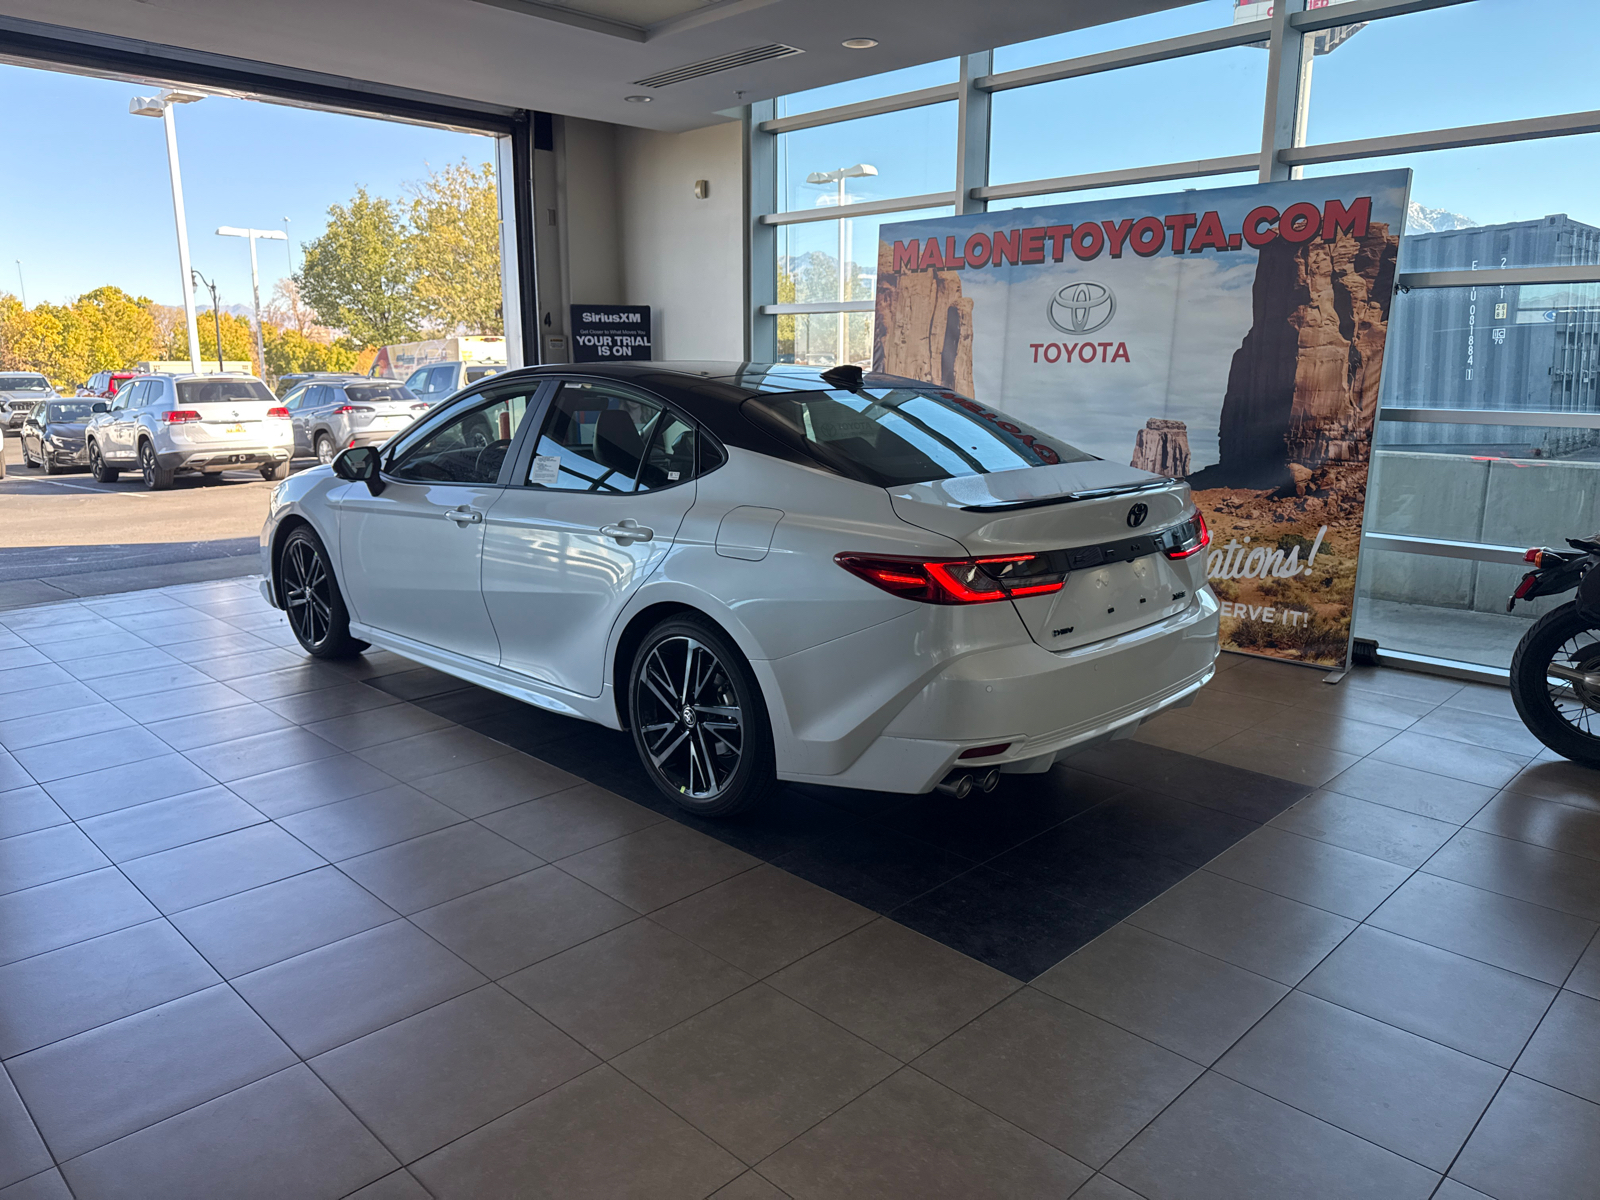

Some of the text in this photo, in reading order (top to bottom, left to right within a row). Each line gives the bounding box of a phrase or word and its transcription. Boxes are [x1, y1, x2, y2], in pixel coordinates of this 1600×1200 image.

[893, 197, 1372, 273] MALONETOYOTA.COM
[544, 312, 552, 328] 4
[582, 312, 641, 322] SiriusXM
[576, 336, 651, 346] YOUR TRIAL
[597, 346, 632, 356] IS ON
[1029, 341, 1131, 364] TOYOTA
[1282, 610, 1309, 628] IT!
